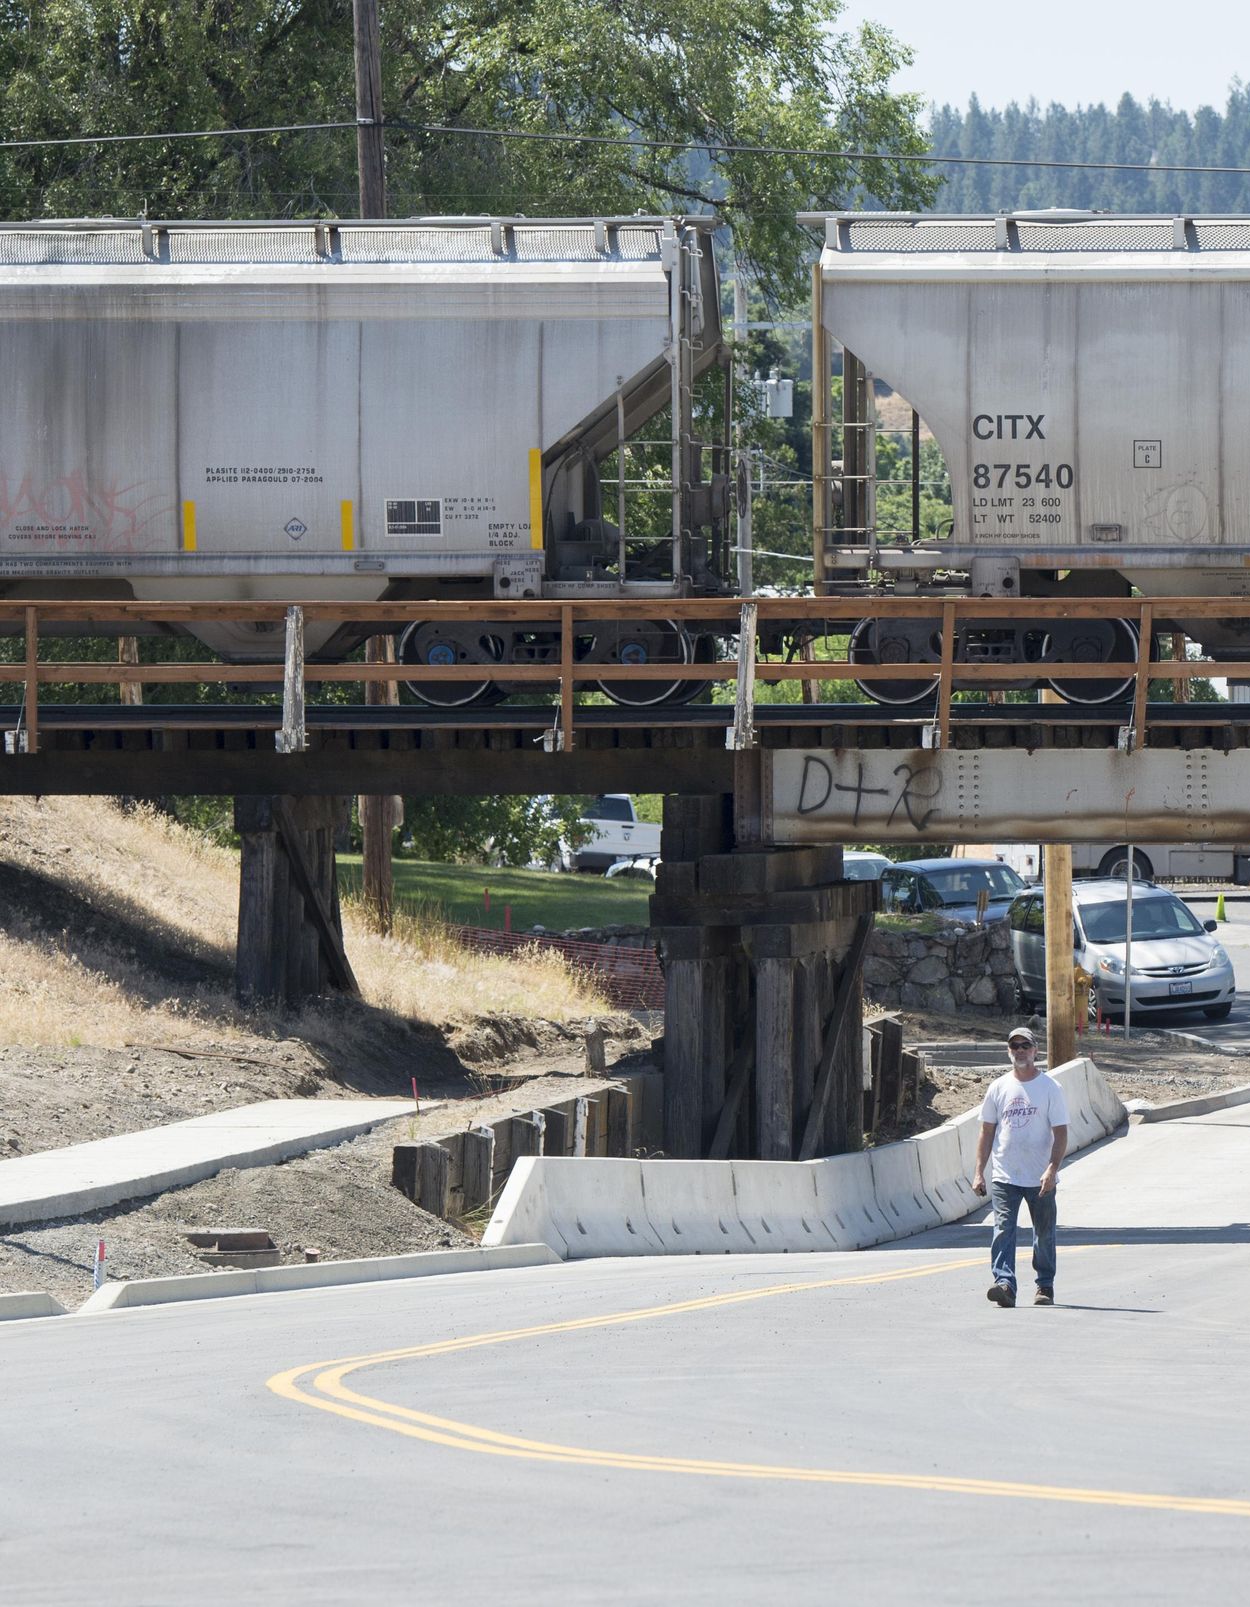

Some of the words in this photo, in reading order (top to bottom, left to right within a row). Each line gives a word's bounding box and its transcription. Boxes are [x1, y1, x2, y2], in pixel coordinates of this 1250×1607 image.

[973, 414, 1046, 440] CITX
[1144, 455, 1151, 464] C
[206, 467, 238, 475] PLASITE
[973, 463, 1074, 490] 87540
[973, 498, 988, 507] LD
[991, 498, 1015, 507] LMT
[974, 515, 988, 523] LT
[997, 515, 1015, 523] WT
[1029, 514, 1061, 523] 52400
